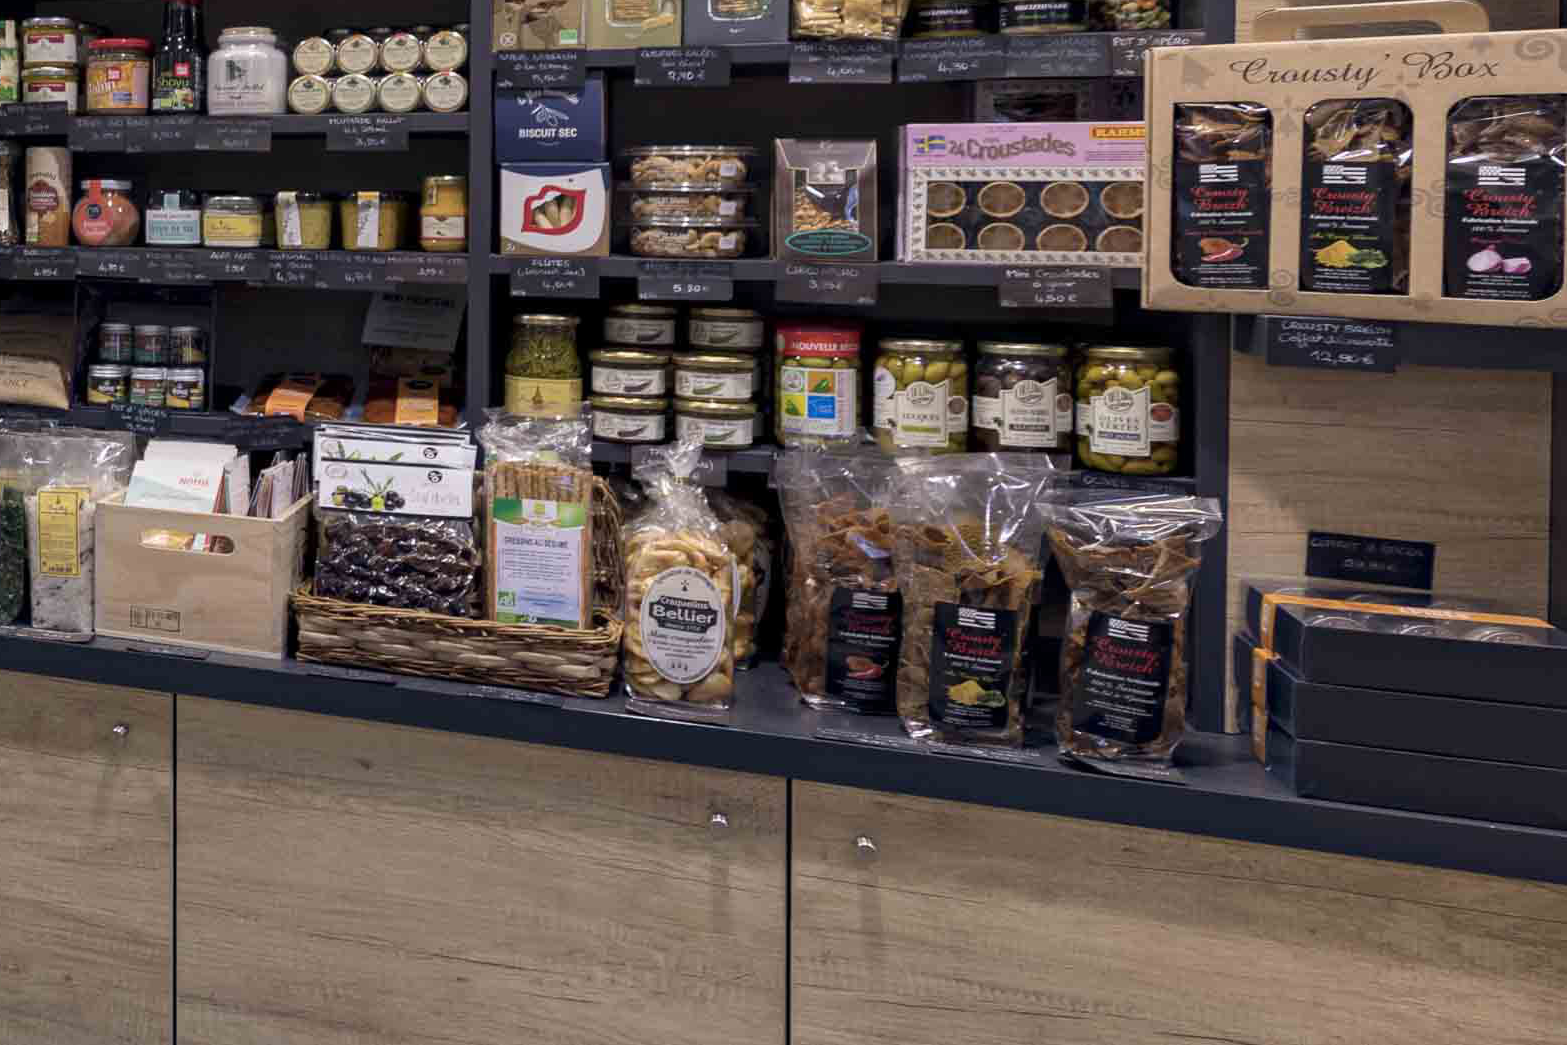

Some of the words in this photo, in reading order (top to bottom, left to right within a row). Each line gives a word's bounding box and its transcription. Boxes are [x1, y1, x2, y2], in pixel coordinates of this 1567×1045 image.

[1401, 50, 1501, 82] Box
[518, 128, 558, 139] BISCUIT
[559, 127, 578, 139] SEC
[966, 132, 1078, 162] Croustades
